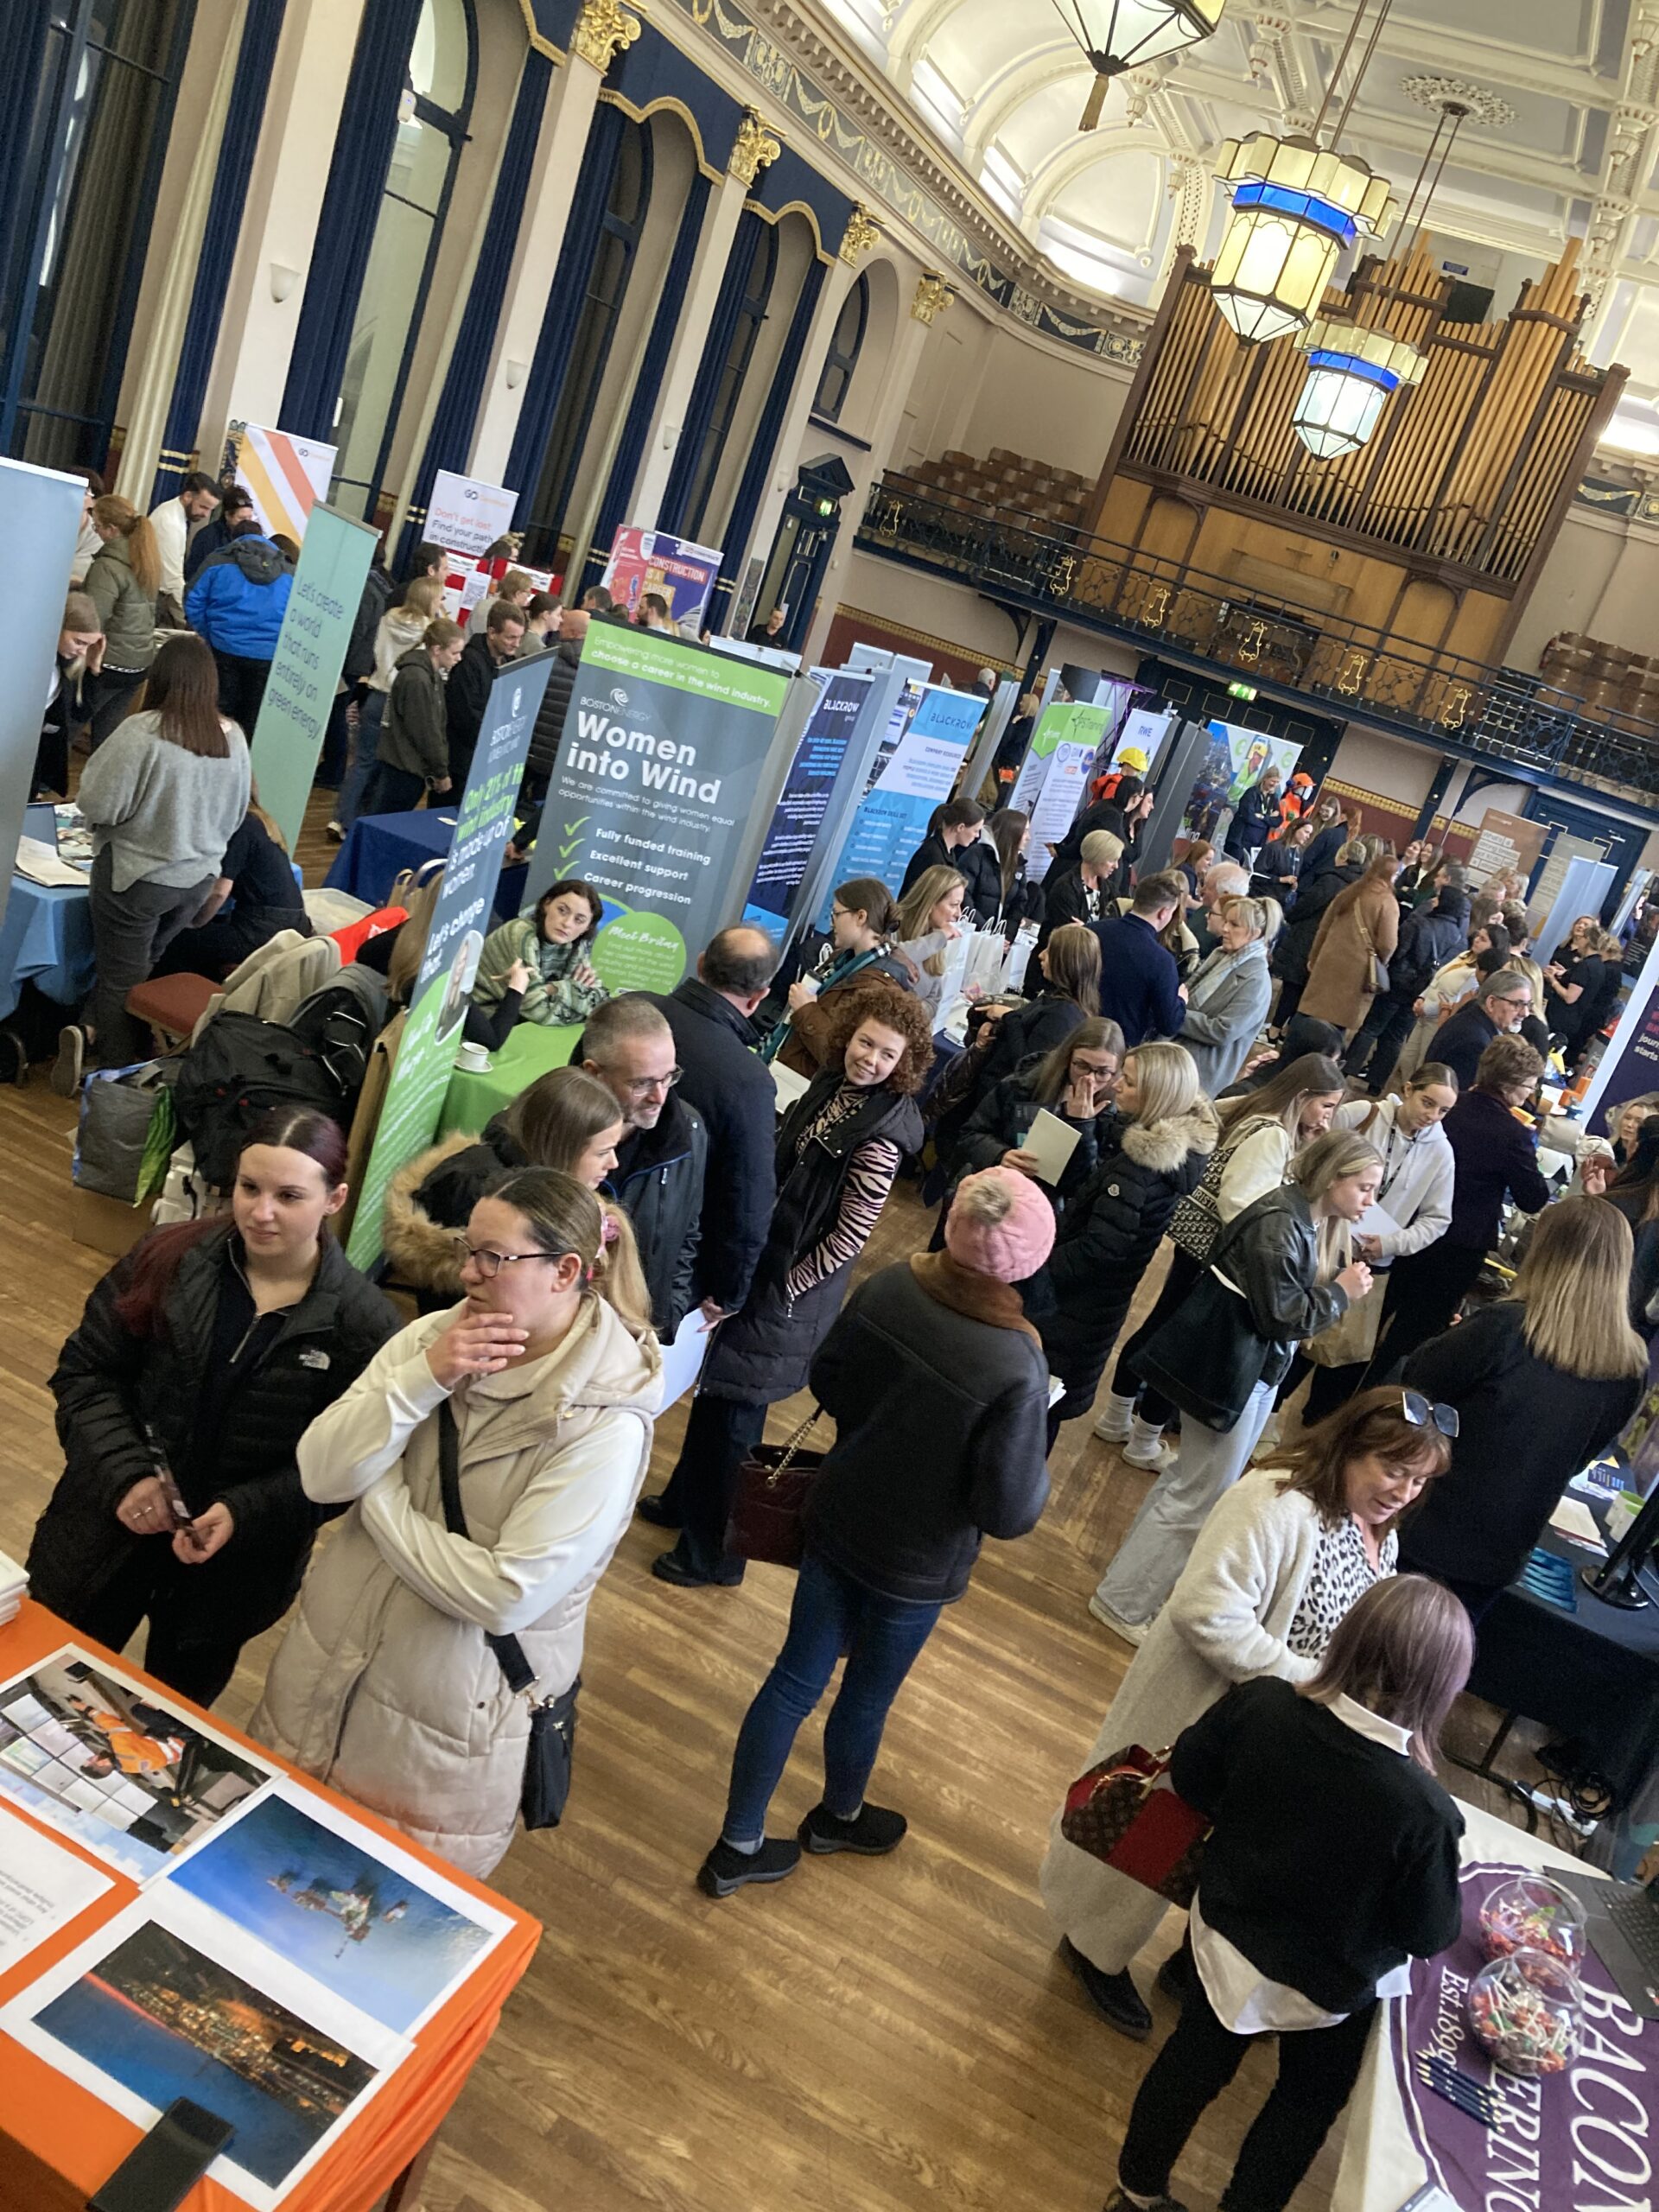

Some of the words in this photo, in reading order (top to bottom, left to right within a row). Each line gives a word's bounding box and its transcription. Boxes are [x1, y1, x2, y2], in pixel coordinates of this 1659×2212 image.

[432, 518, 453, 533] Find
[454, 525, 474, 540] your
[439, 536, 486, 555] constructi
[648, 556, 705, 583] CONSTRUCTION
[296, 574, 316, 603] Let's
[316, 592, 345, 620] create
[296, 612, 322, 638] world
[302, 646, 320, 671] runs
[594, 636, 648, 660] Empowering
[650, 652, 674, 666] more
[676, 659, 709, 677] women
[711, 670, 721, 680] to
[276, 661, 306, 696] entirely
[306, 683, 318, 702] on
[591, 649, 629, 667] choose
[640, 663, 675, 680] career
[676, 671, 686, 682] in
[687, 675, 705, 688] the
[705, 680, 730, 696] wind
[732, 687, 772, 708] industry.
[267, 688, 291, 716] green
[290, 706, 321, 741] energy
[823, 698, 860, 713] BLACKROW
[929, 713, 976, 730] BLACKROW
[578, 710, 696, 767] Women
[1138, 725, 1153, 737] RWE
[566, 741, 630, 781] into
[641, 760, 722, 804] Wind
[557, 787, 614, 809] opportunities
[614, 800, 639, 814] within
[641, 806, 657, 819] the
[657, 812, 677, 824] wind
[562, 775, 576, 786] We
[577, 779, 594, 791] are
[594, 785, 640, 803] committed
[641, 795, 652, 805] to
[652, 798, 678, 814] giving
[679, 806, 710, 821] women
[711, 814, 735, 827] equal
[595, 828, 622, 843] Fully
[623, 834, 665, 853] funded
[667, 845, 711, 866] training
[589, 849, 643, 870] Excellent
[644, 863, 690, 881] support
[584, 872, 625, 889] Career
[625, 882, 692, 906] progression
[1634, 1046, 1659, 1061] starts
